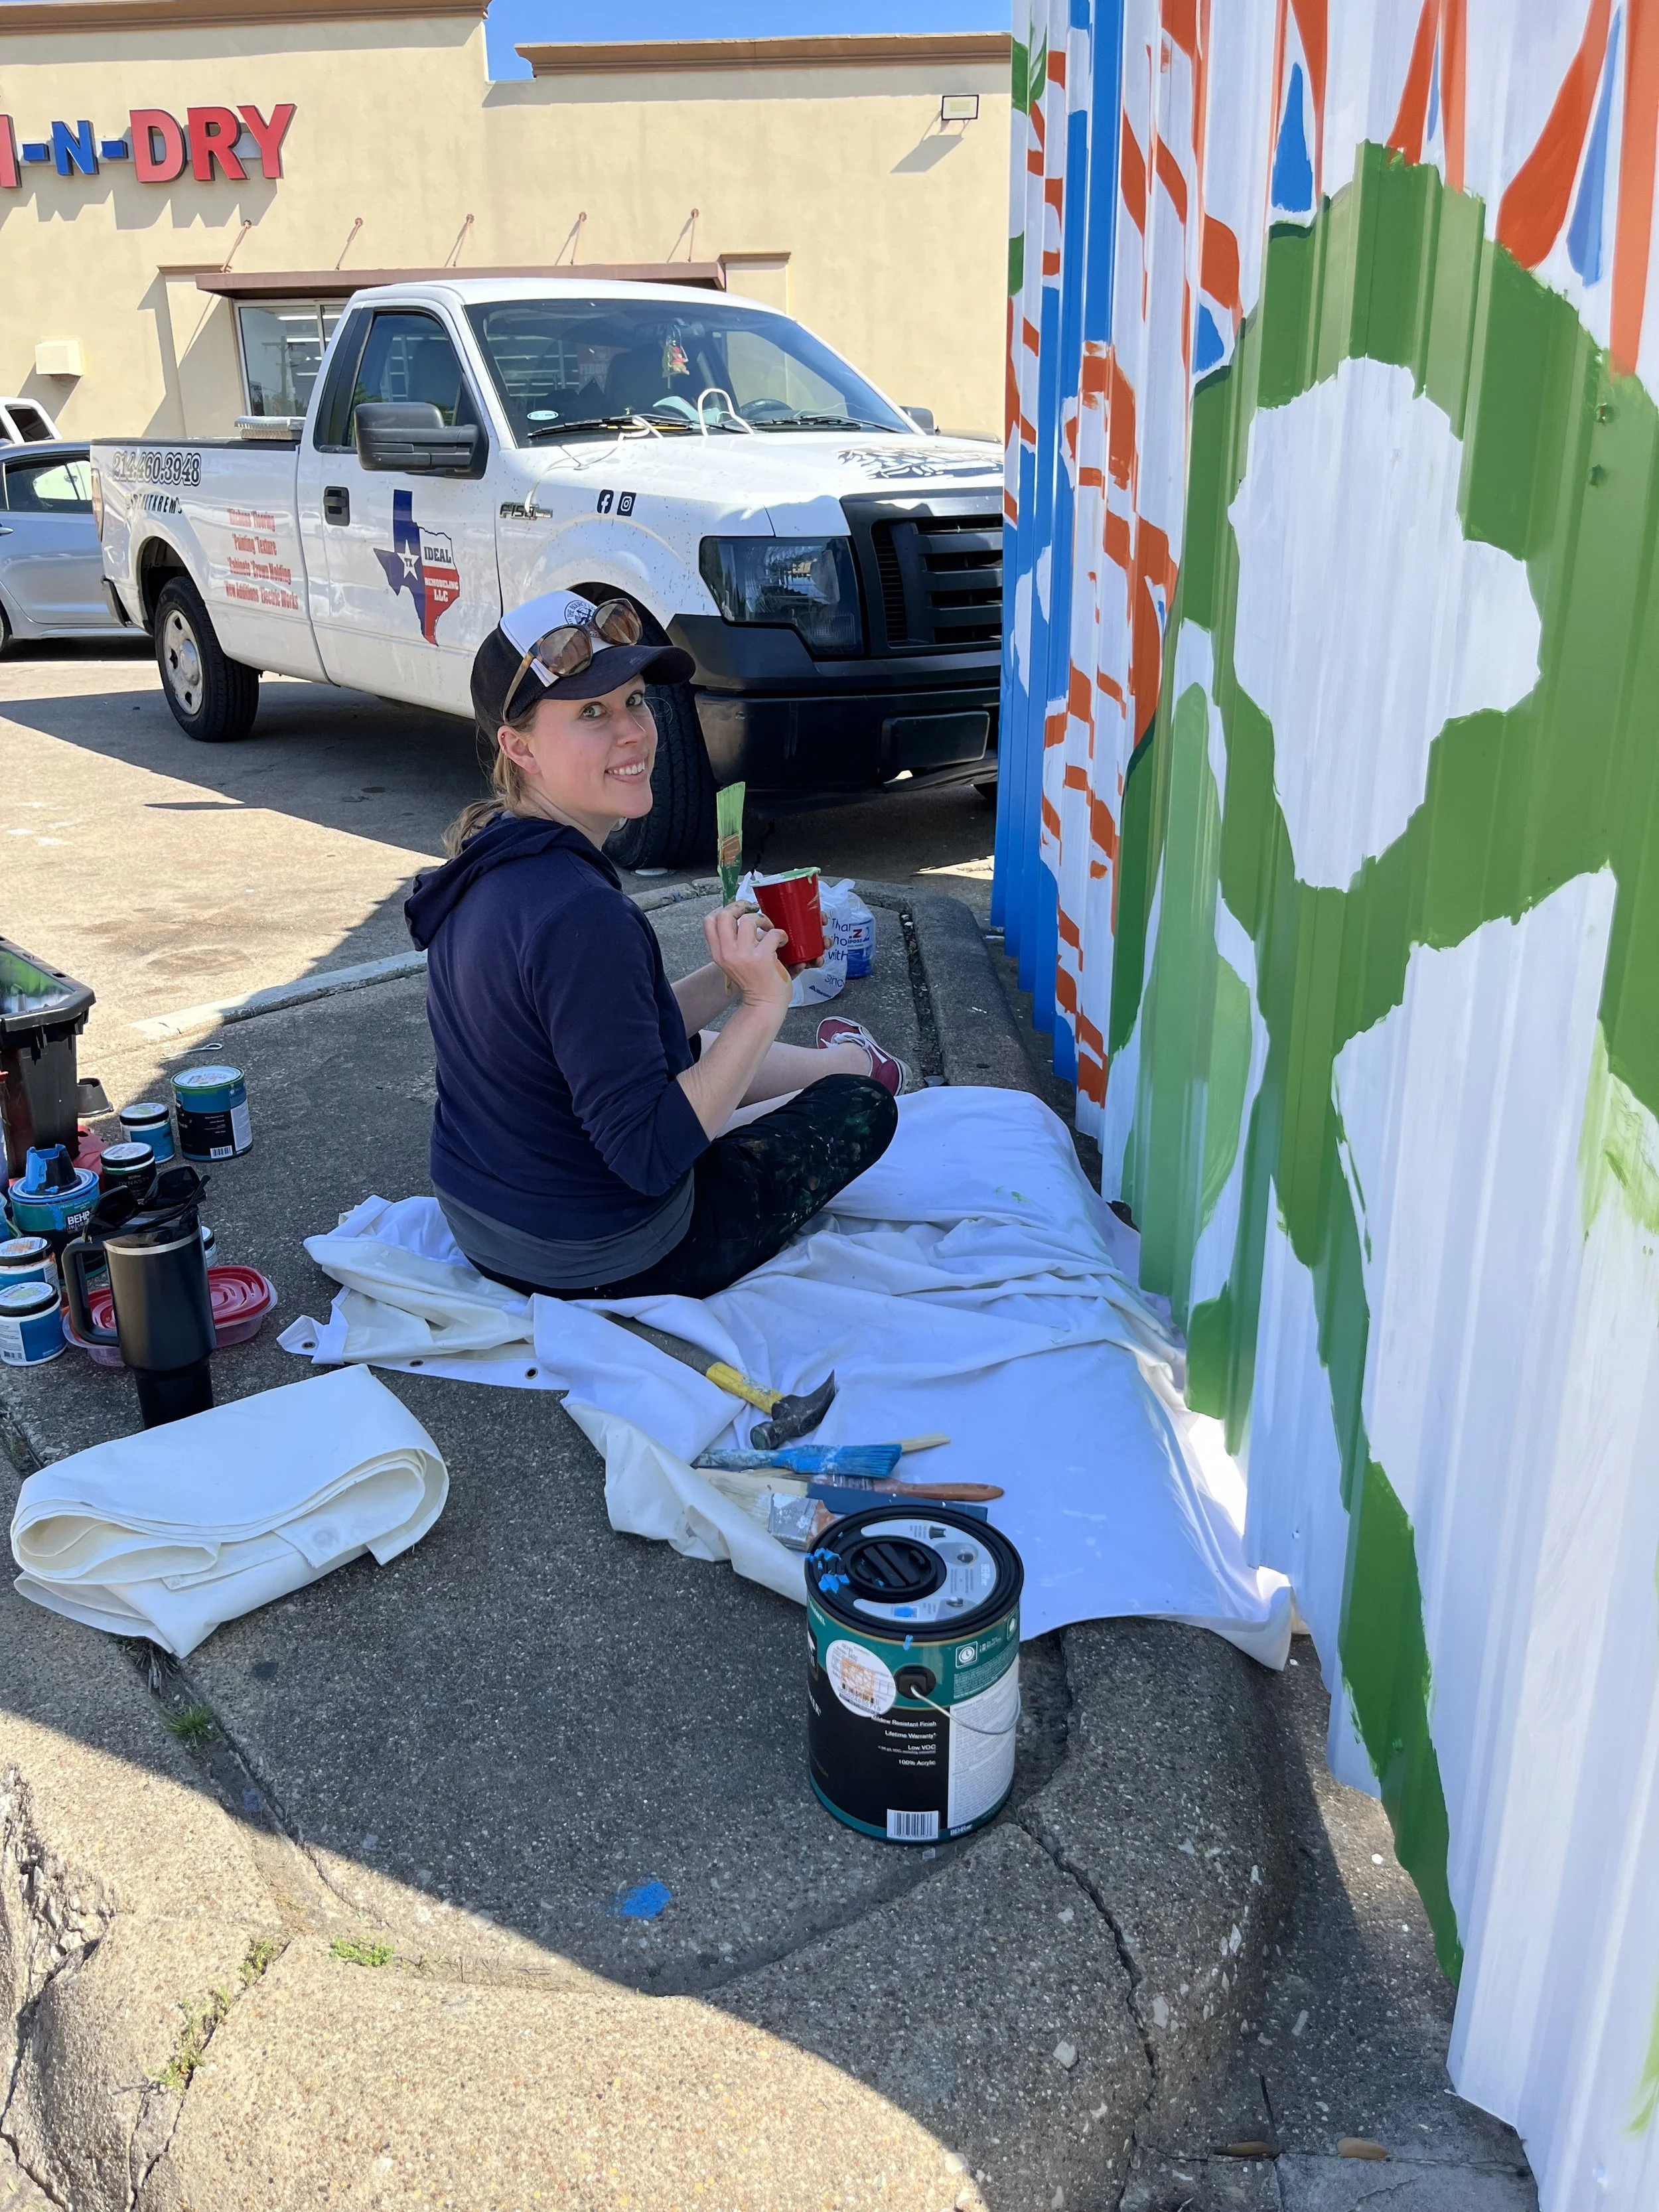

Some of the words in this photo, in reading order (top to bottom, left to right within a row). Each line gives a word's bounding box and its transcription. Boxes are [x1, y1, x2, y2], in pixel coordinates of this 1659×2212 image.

[424, 546, 452, 563] IDEAL
[404, 557, 413, 567] TX
[424, 577, 459, 590] REMODELING
[433, 589, 449, 603] LLC
[117, 1176, 149, 1186] DYNASTY
[892, 1719, 918, 1728] Resistant
[885, 1730, 907, 1738] Lifetime
[950, 1825, 966, 1836] BEHR
